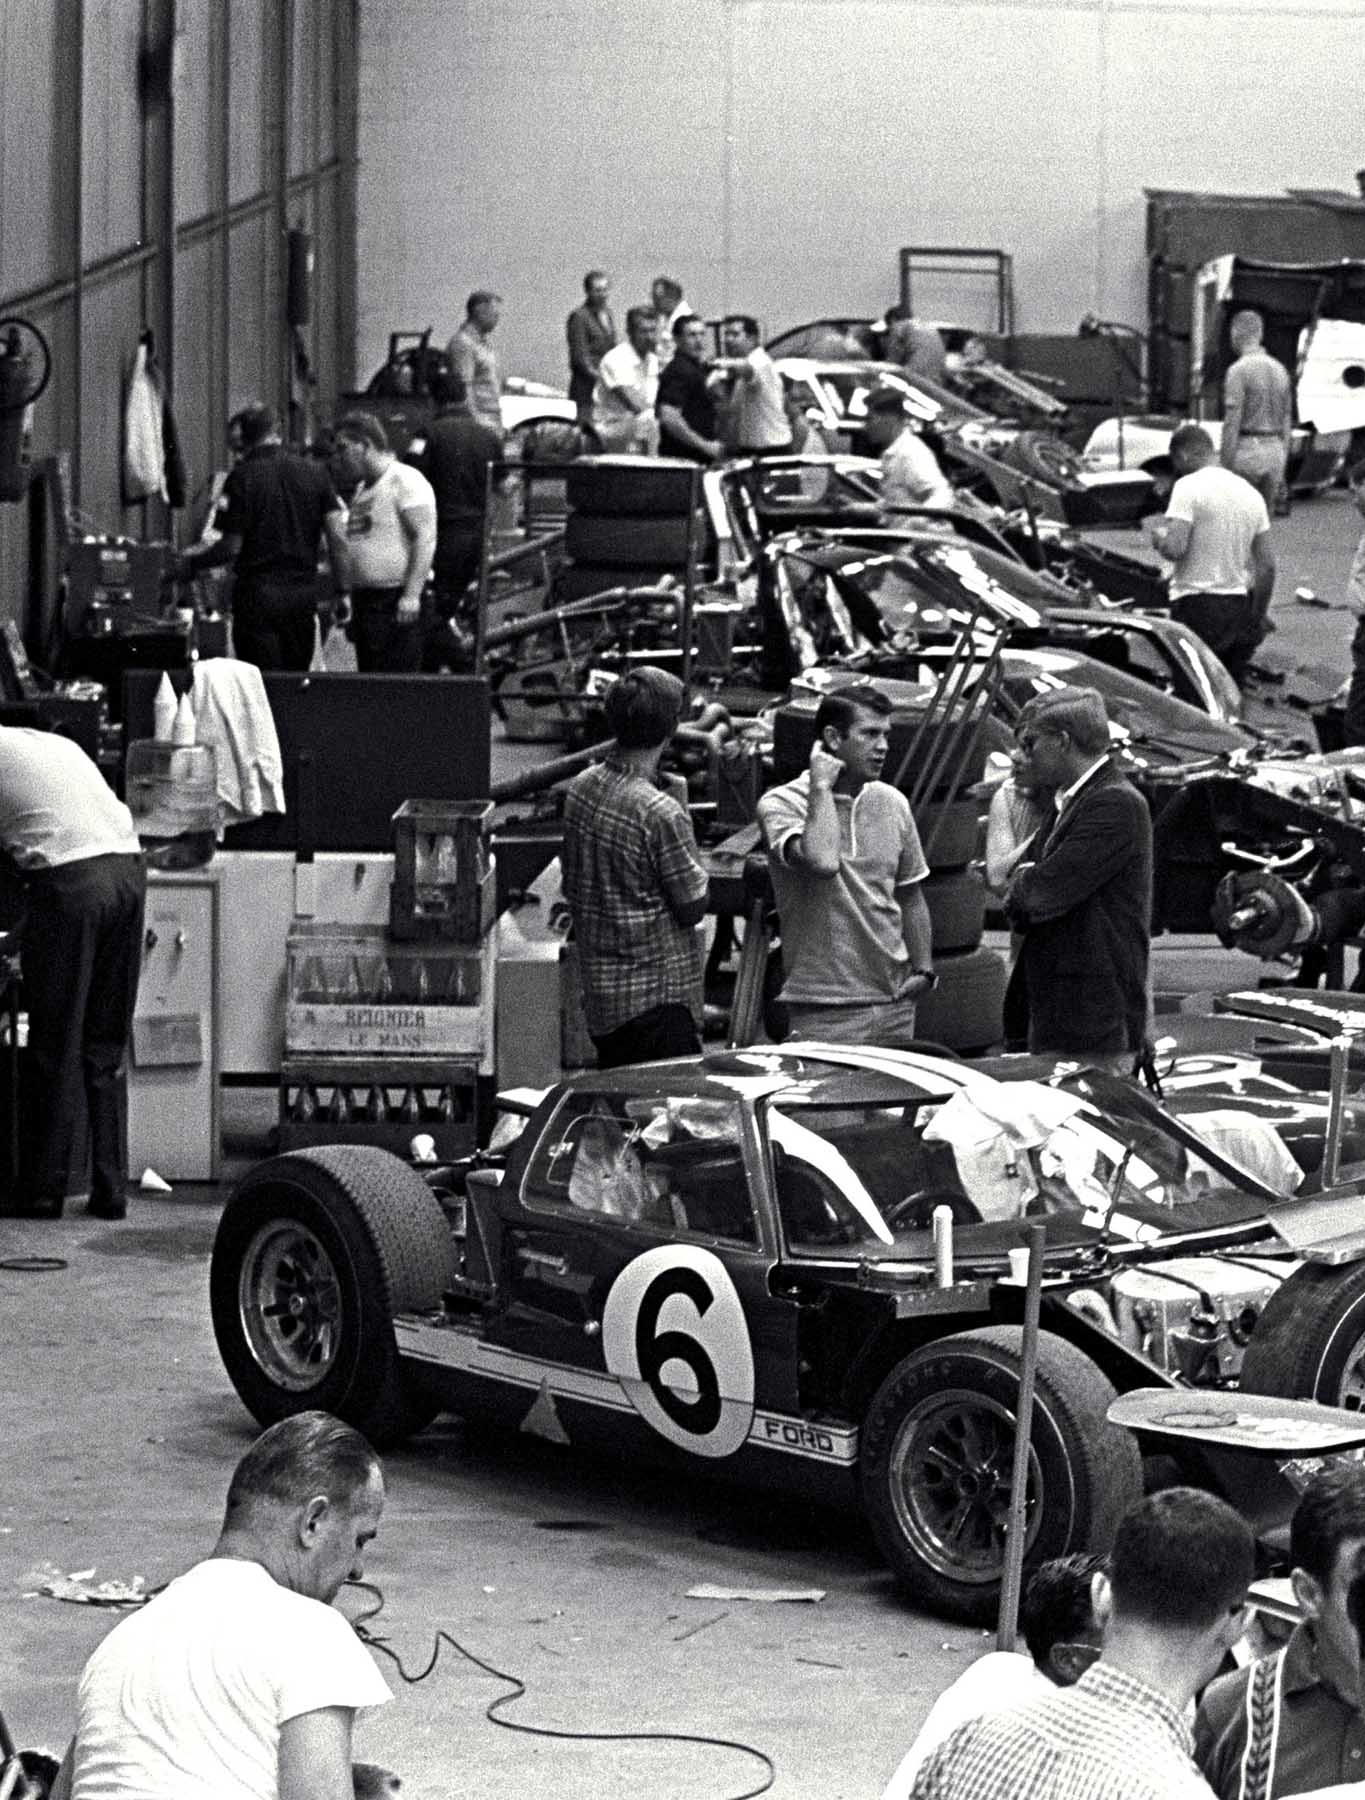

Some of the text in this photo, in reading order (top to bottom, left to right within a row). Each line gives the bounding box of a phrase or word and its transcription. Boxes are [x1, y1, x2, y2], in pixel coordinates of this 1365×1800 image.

[379, 1032, 422, 1048] MANS
[635, 1266, 722, 1436] 6
[765, 1420, 834, 1453] FORD
